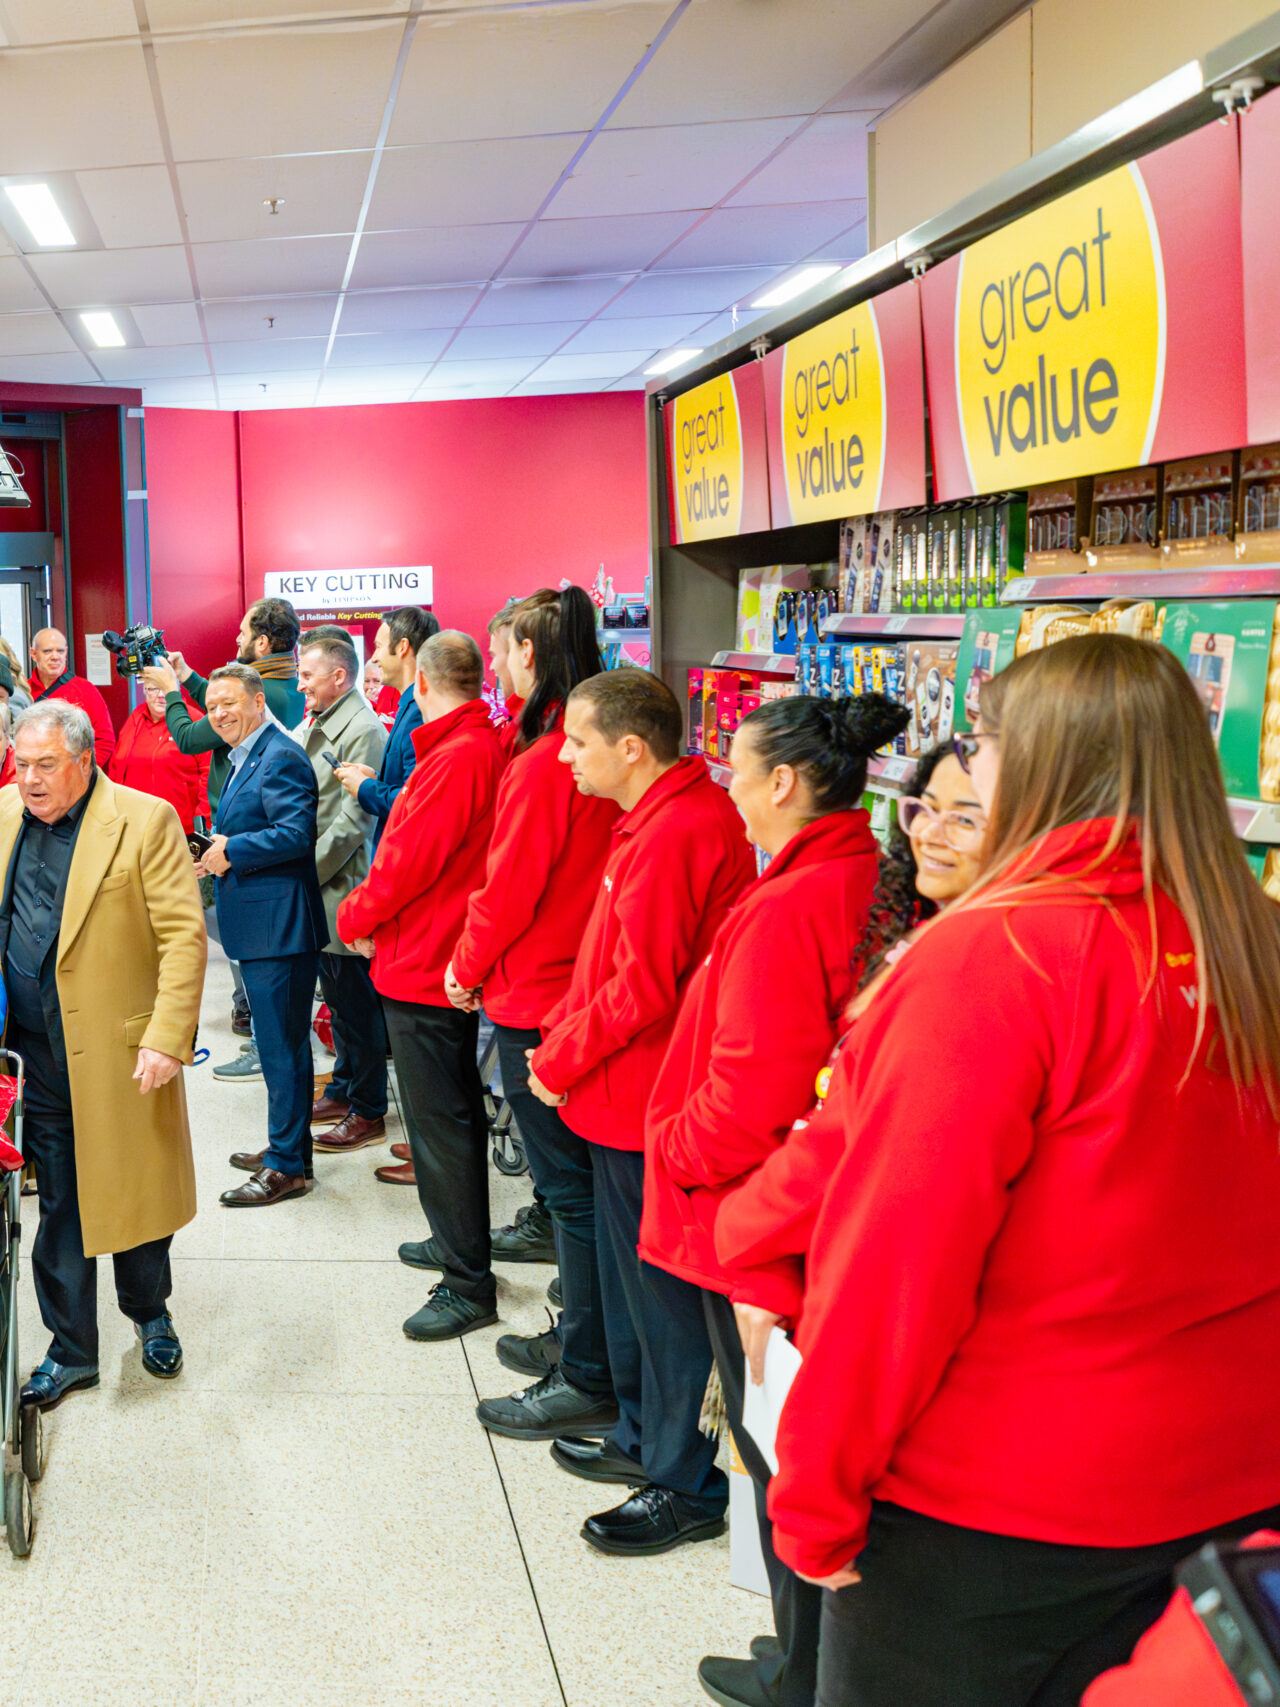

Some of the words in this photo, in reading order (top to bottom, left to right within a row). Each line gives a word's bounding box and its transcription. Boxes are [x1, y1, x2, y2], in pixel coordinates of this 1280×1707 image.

[980, 207, 1111, 375] great
[794, 328, 860, 438] great
[983, 354, 1119, 457] value
[682, 392, 725, 474] great
[797, 427, 864, 499] value
[684, 466, 729, 522] value
[280, 577, 317, 593] KEY
[325, 572, 419, 591] CUTTING
[307, 612, 336, 620] Reliable
[337, 612, 352, 620] Key
[354, 611, 383, 620] Cutting
